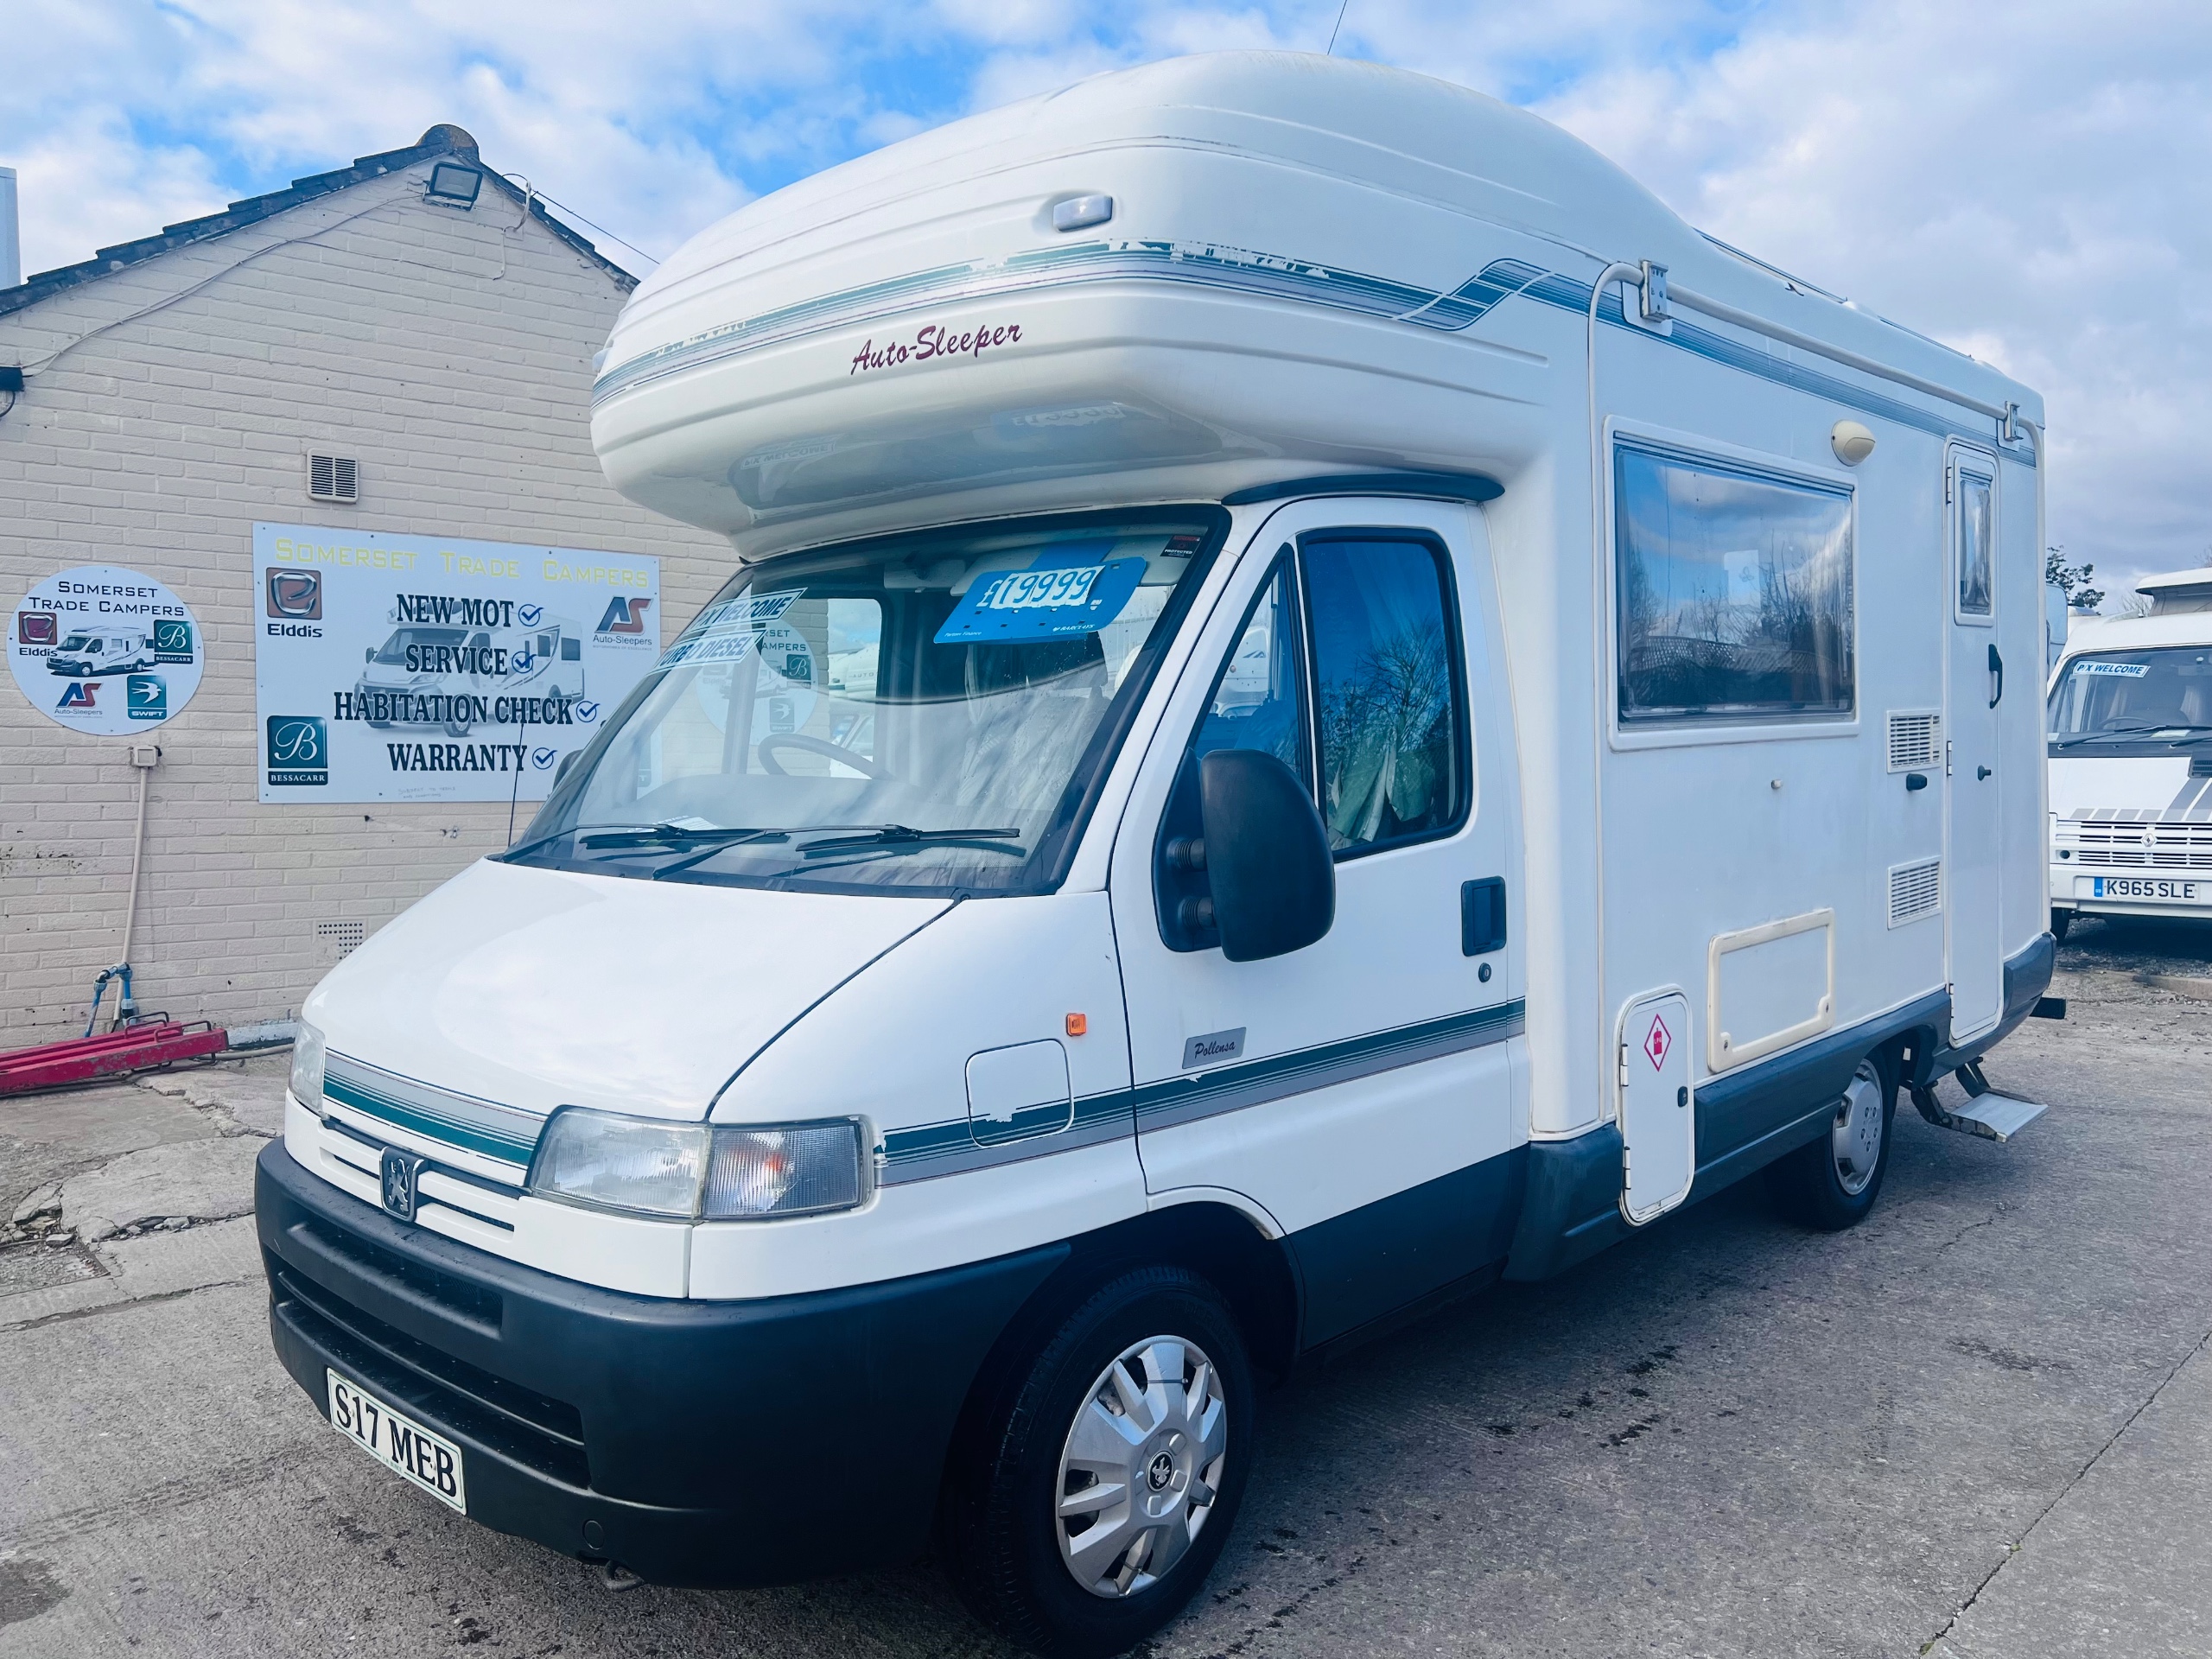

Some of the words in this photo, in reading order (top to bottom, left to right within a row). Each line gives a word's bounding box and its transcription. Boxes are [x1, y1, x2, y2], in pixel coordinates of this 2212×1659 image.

[851, 324, 1023, 376] Auto-Sleeper
[276, 538, 418, 571] SOMERSET
[440, 551, 520, 579] TRADE
[543, 560, 648, 588] CAMPERS
[58, 581, 158, 598] SOMERSET
[29, 596, 90, 612] TRADE
[99, 601, 185, 616] CAMPERS
[397, 593, 454, 625] NEW
[461, 597, 514, 628] MOT
[711, 596, 793, 624] WELCOME
[267, 623, 323, 638] Elddis
[1059, 623, 1096, 632] BARCLAYS
[593, 634, 652, 646] Auto-Sleepers
[696, 636, 753, 659] DIESEL
[762, 642, 806, 652] AMPERS
[19, 647, 58, 658] Elddis
[405, 643, 508, 677] SERVICE
[2077, 664, 2094, 672] P/X
[2094, 664, 2145, 675] WELCOME
[54, 708, 103, 716] Auto-Sleepers
[334, 691, 488, 724] HABITATION
[494, 695, 574, 725] CHECK
[387, 743, 528, 772] WARRANTY
[2107, 880, 2154, 897] K965
[2158, 882, 2196, 899] SLE
[1194, 1040, 1236, 1059] Pollensa
[335, 1383, 378, 1449] S17
[387, 1417, 457, 1497] MEB
